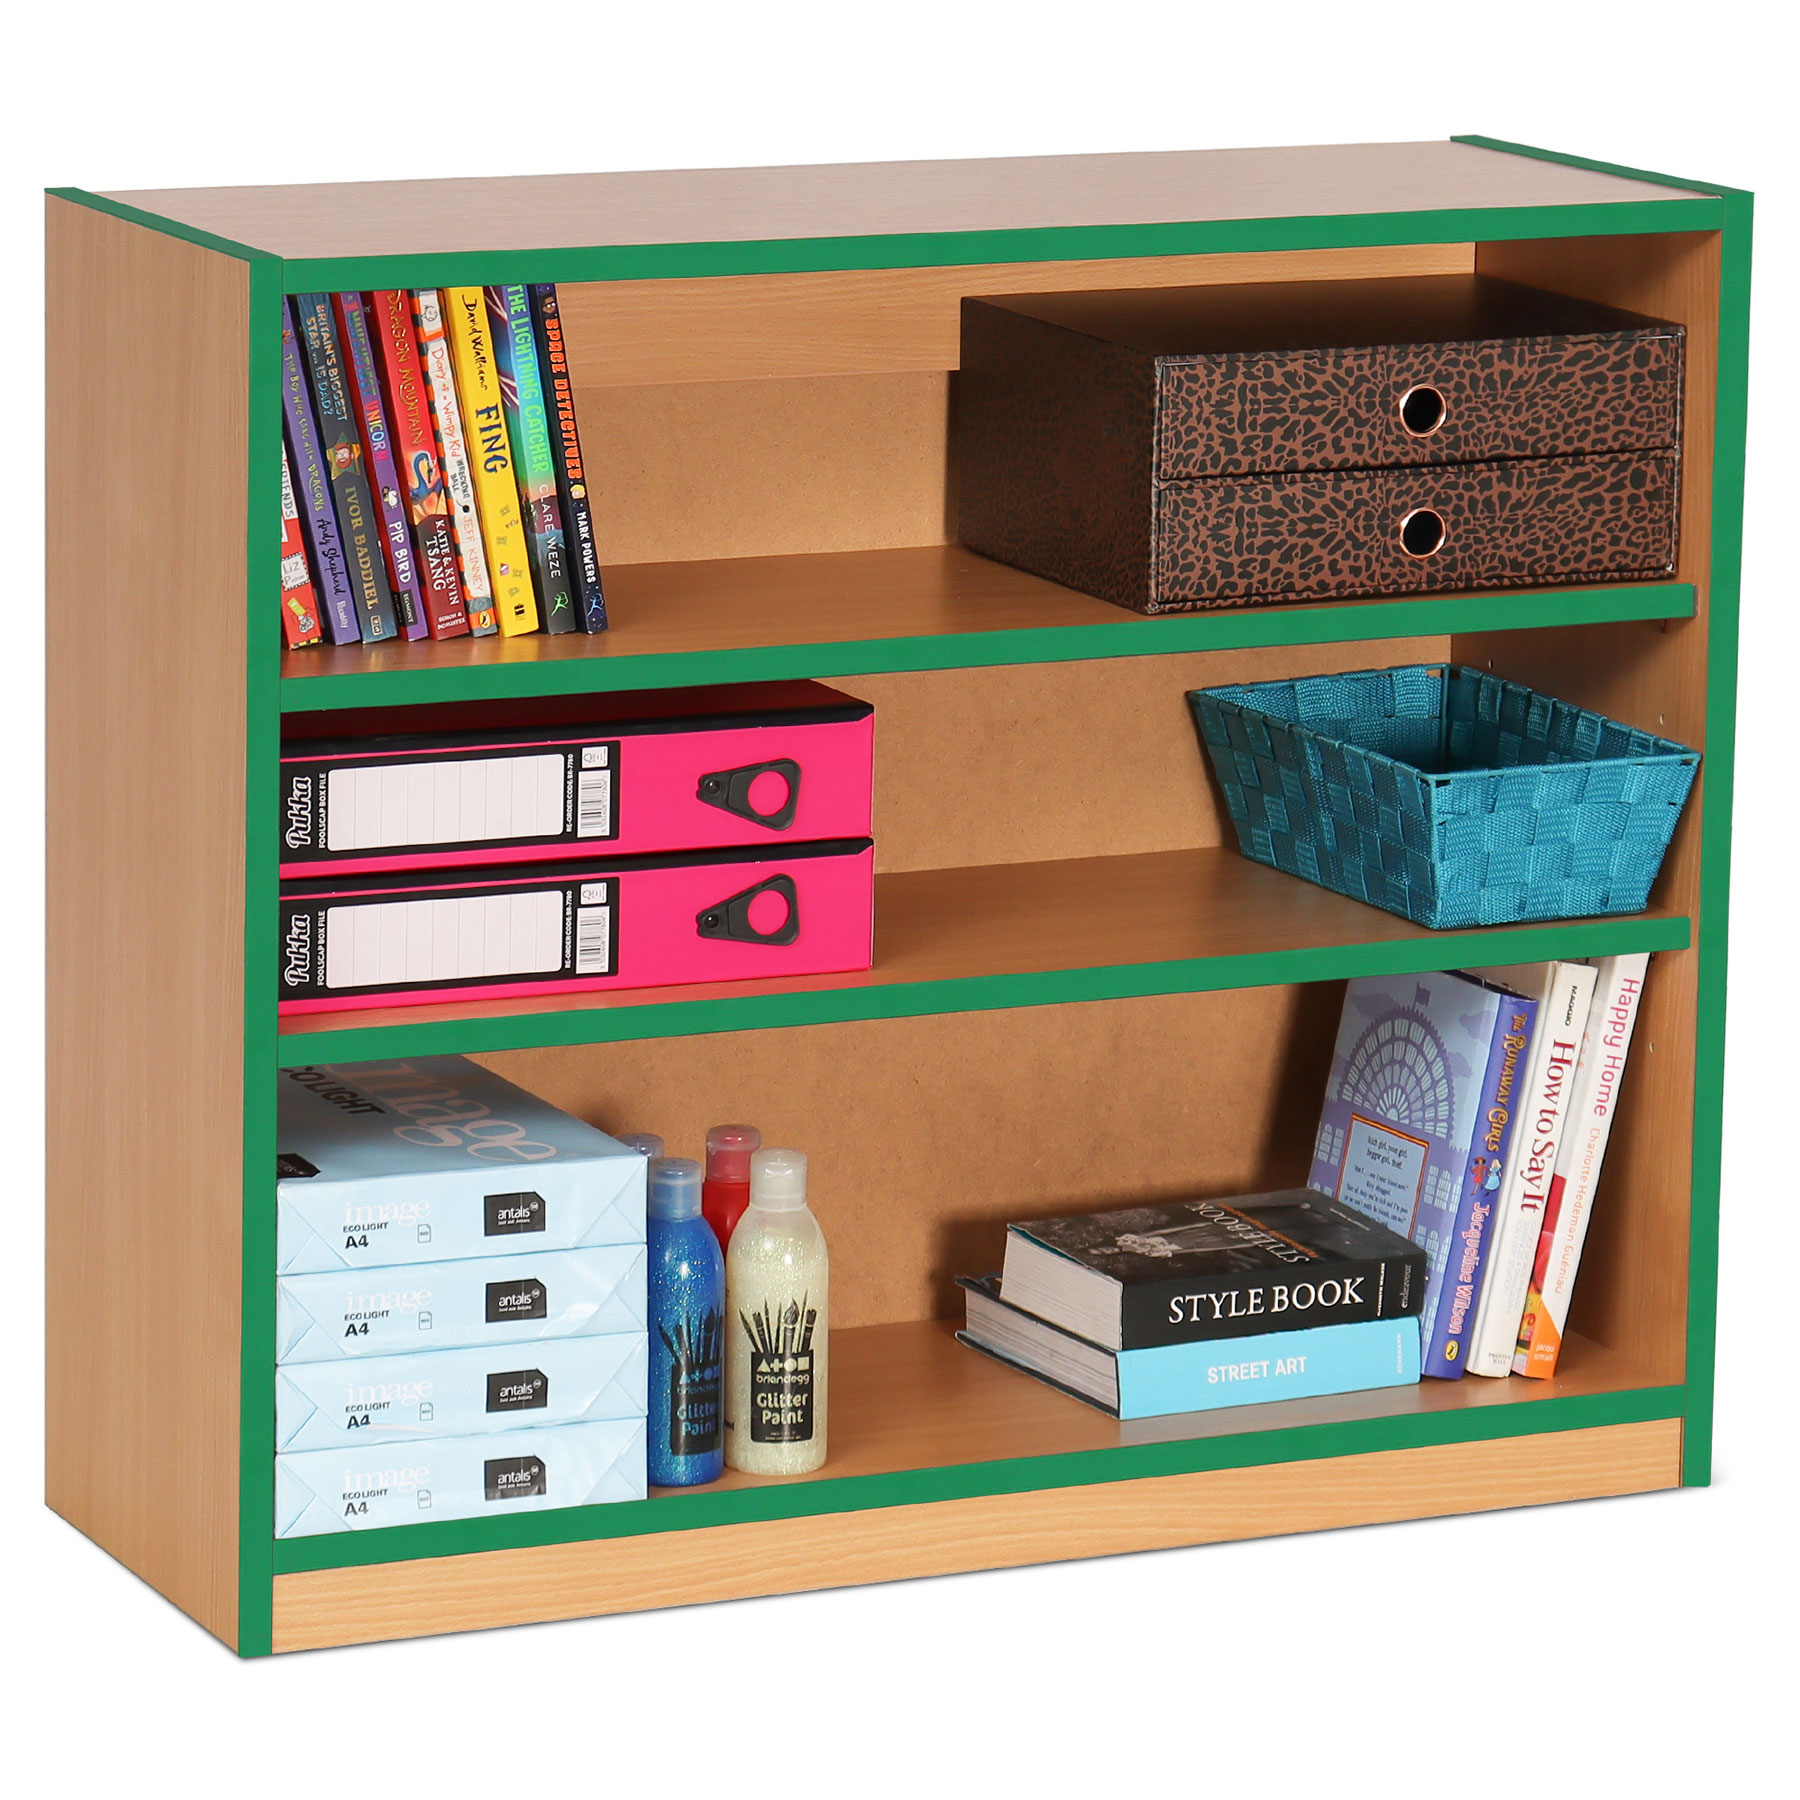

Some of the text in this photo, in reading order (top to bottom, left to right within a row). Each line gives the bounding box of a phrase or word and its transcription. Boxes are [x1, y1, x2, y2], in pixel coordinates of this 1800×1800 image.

[306, 317, 320, 350] STAR
[462, 294, 488, 391] David Walliams
[315, 303, 348, 421] BRITAIN'S BIGGEST
[315, 365, 326, 379] IS
[387, 290, 426, 445] DRAGON MOUNTAIN
[507, 285, 550, 473] THE LIGHTNING CATCHER
[317, 382, 334, 415] DAD?
[431, 347, 447, 380] Diary
[449, 439, 462, 458] Kid
[545, 318, 583, 480] SPACE DETECTIVES
[365, 400, 390, 462] UNICORN
[475, 402, 509, 474] FING
[450, 473, 460, 493] BALL
[317, 518, 335, 546] Andy
[344, 486, 379, 610] IVOR BADDIEL
[388, 521, 405, 544] PIP
[538, 483, 561, 579] CLARE WEZE
[576, 511, 597, 584] MARK POWERS
[394, 548, 411, 583] BIRD
[426, 537, 446, 590] TSANG
[435, 520, 460, 606] KATIE & KEVIN
[463, 516, 484, 592] JEFF KINNEY
[319, 772, 327, 789] FILE
[285, 776, 312, 850] Pukka
[318, 807, 326, 848] FOOLSCAP
[284, 913, 311, 987] Pukka
[317, 910, 326, 986] FOOLSCAP BOX FILE
[1564, 985, 1578, 1026] MAGGIO
[1593, 978, 1640, 1118] Happy Home
[1497, 1033, 1527, 1107] RUNAWAY
[304, 1081, 386, 1114] LIGHT
[1483, 1106, 1509, 1152] GIRLS
[1519, 1039, 1577, 1214] How to Say It
[1578, 1127, 1601, 1182] Charlotte
[343, 1222, 389, 1233] ECO LIGHT
[344, 1200, 431, 1227] image
[497, 1206, 531, 1220] antalis
[1567, 1185, 1590, 1242] Hedeman
[344, 1234, 369, 1250] A4
[1448, 1202, 1491, 1335] Jacqueline Wilson
[344, 1310, 390, 1321] ECO LIGHT
[345, 1288, 432, 1314] image
[498, 1293, 532, 1307] antalis
[1168, 1277, 1365, 1325] STYLE BOOK
[344, 1322, 370, 1337] A4
[1207, 1356, 1308, 1385] STREET ART
[345, 1401, 391, 1413] ECO LIGHT
[346, 1379, 433, 1406] image
[499, 1383, 533, 1398] antalis
[756, 1392, 809, 1408] Glitter
[347, 1414, 371, 1429] A4
[762, 1409, 804, 1426] Paint
[344, 1465, 430, 1493] image
[497, 1469, 531, 1484] antalis
[343, 1489, 388, 1500] ECO LIGHT
[344, 1501, 369, 1517] A4
